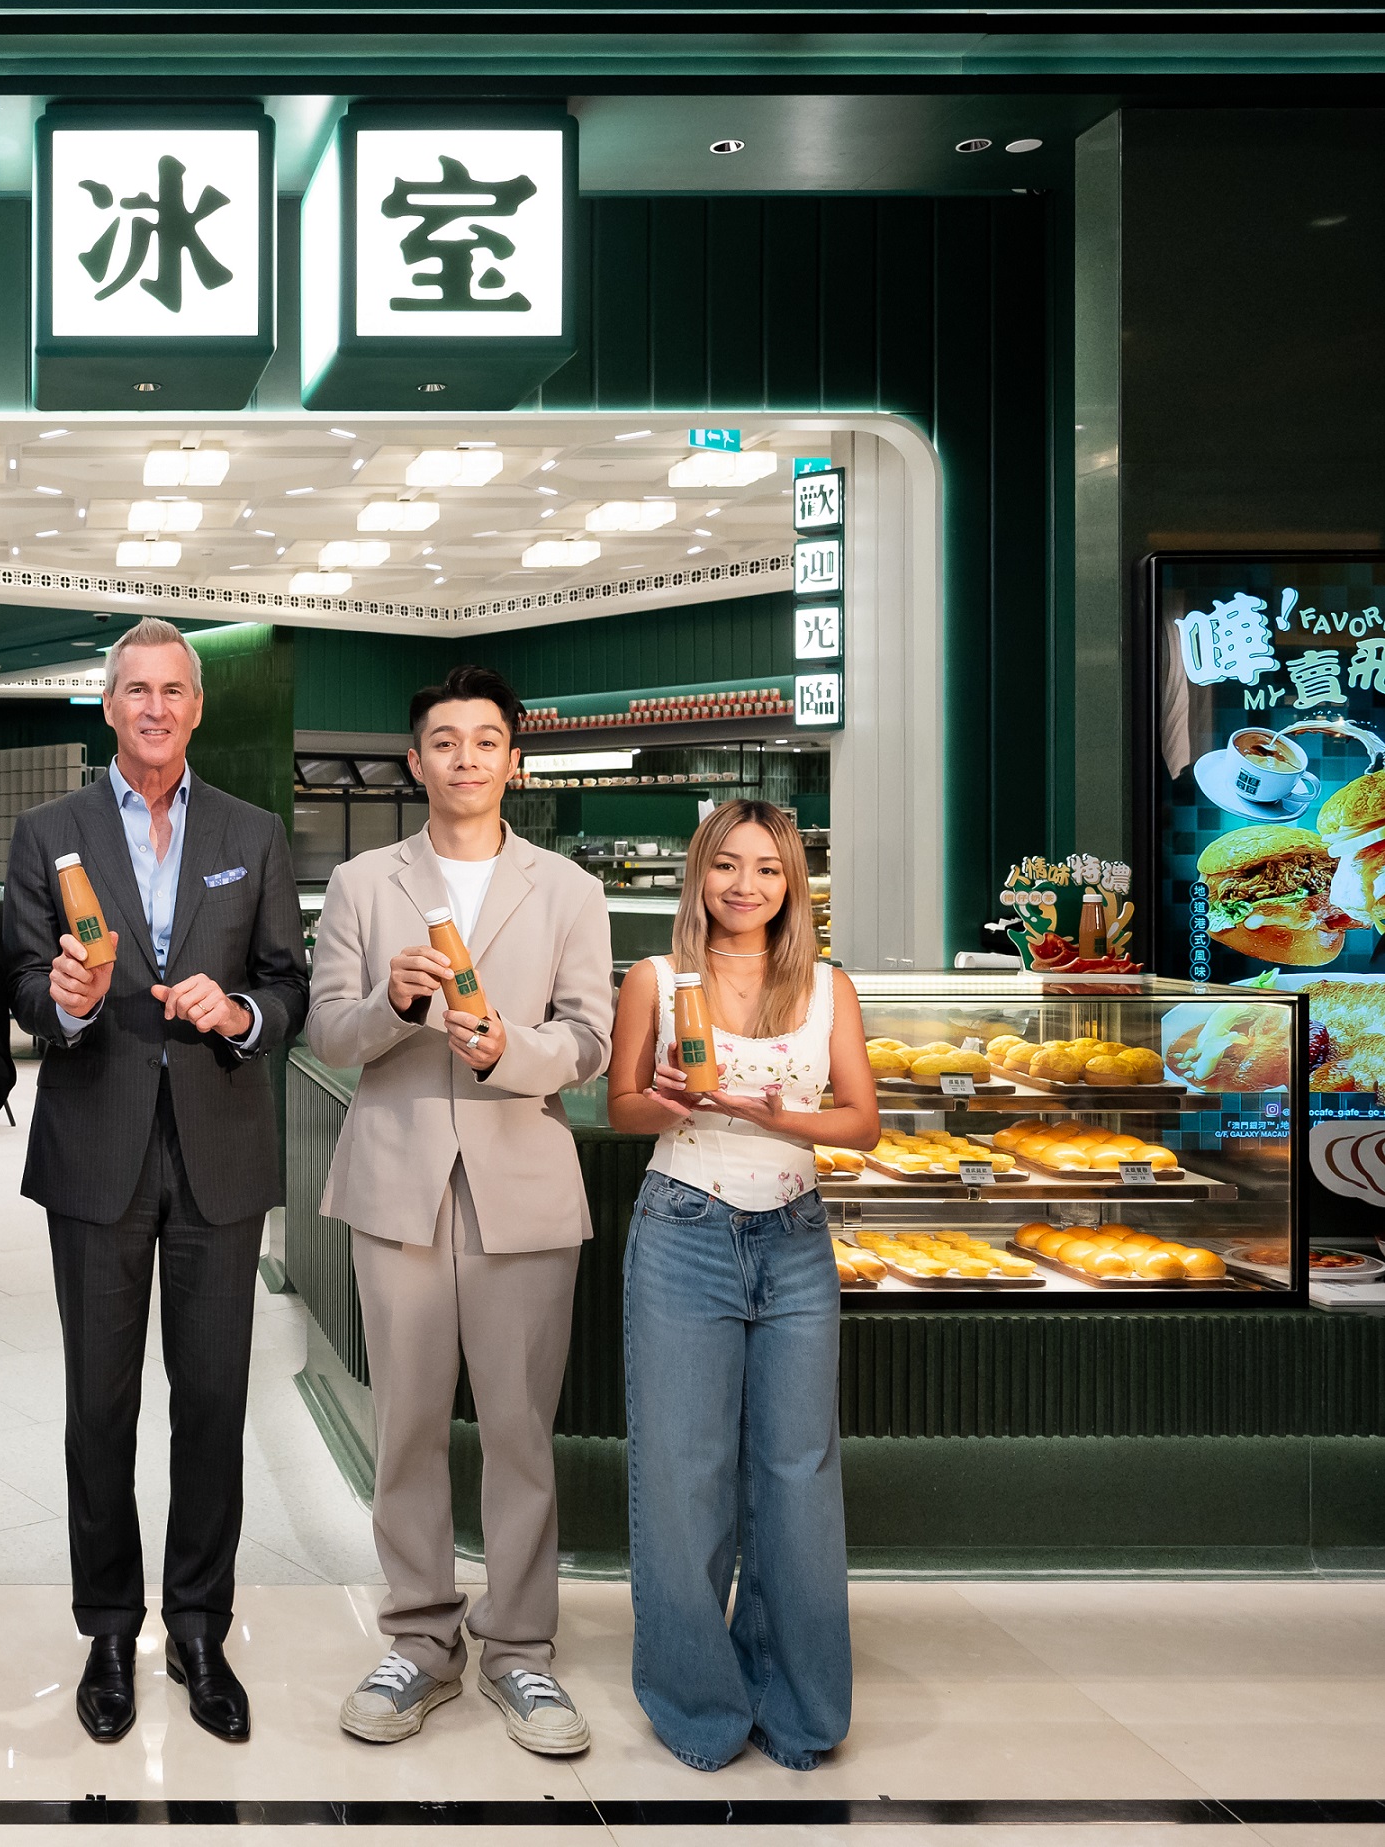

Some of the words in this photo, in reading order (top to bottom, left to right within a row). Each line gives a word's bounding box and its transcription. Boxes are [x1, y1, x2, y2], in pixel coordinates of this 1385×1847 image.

[800, 484, 834, 716] 歡迎光臨
[1299, 606, 1385, 638] FAVOR
[1244, 685, 1285, 710] MY
[1230, 1130, 1259, 1138] GALAXY
